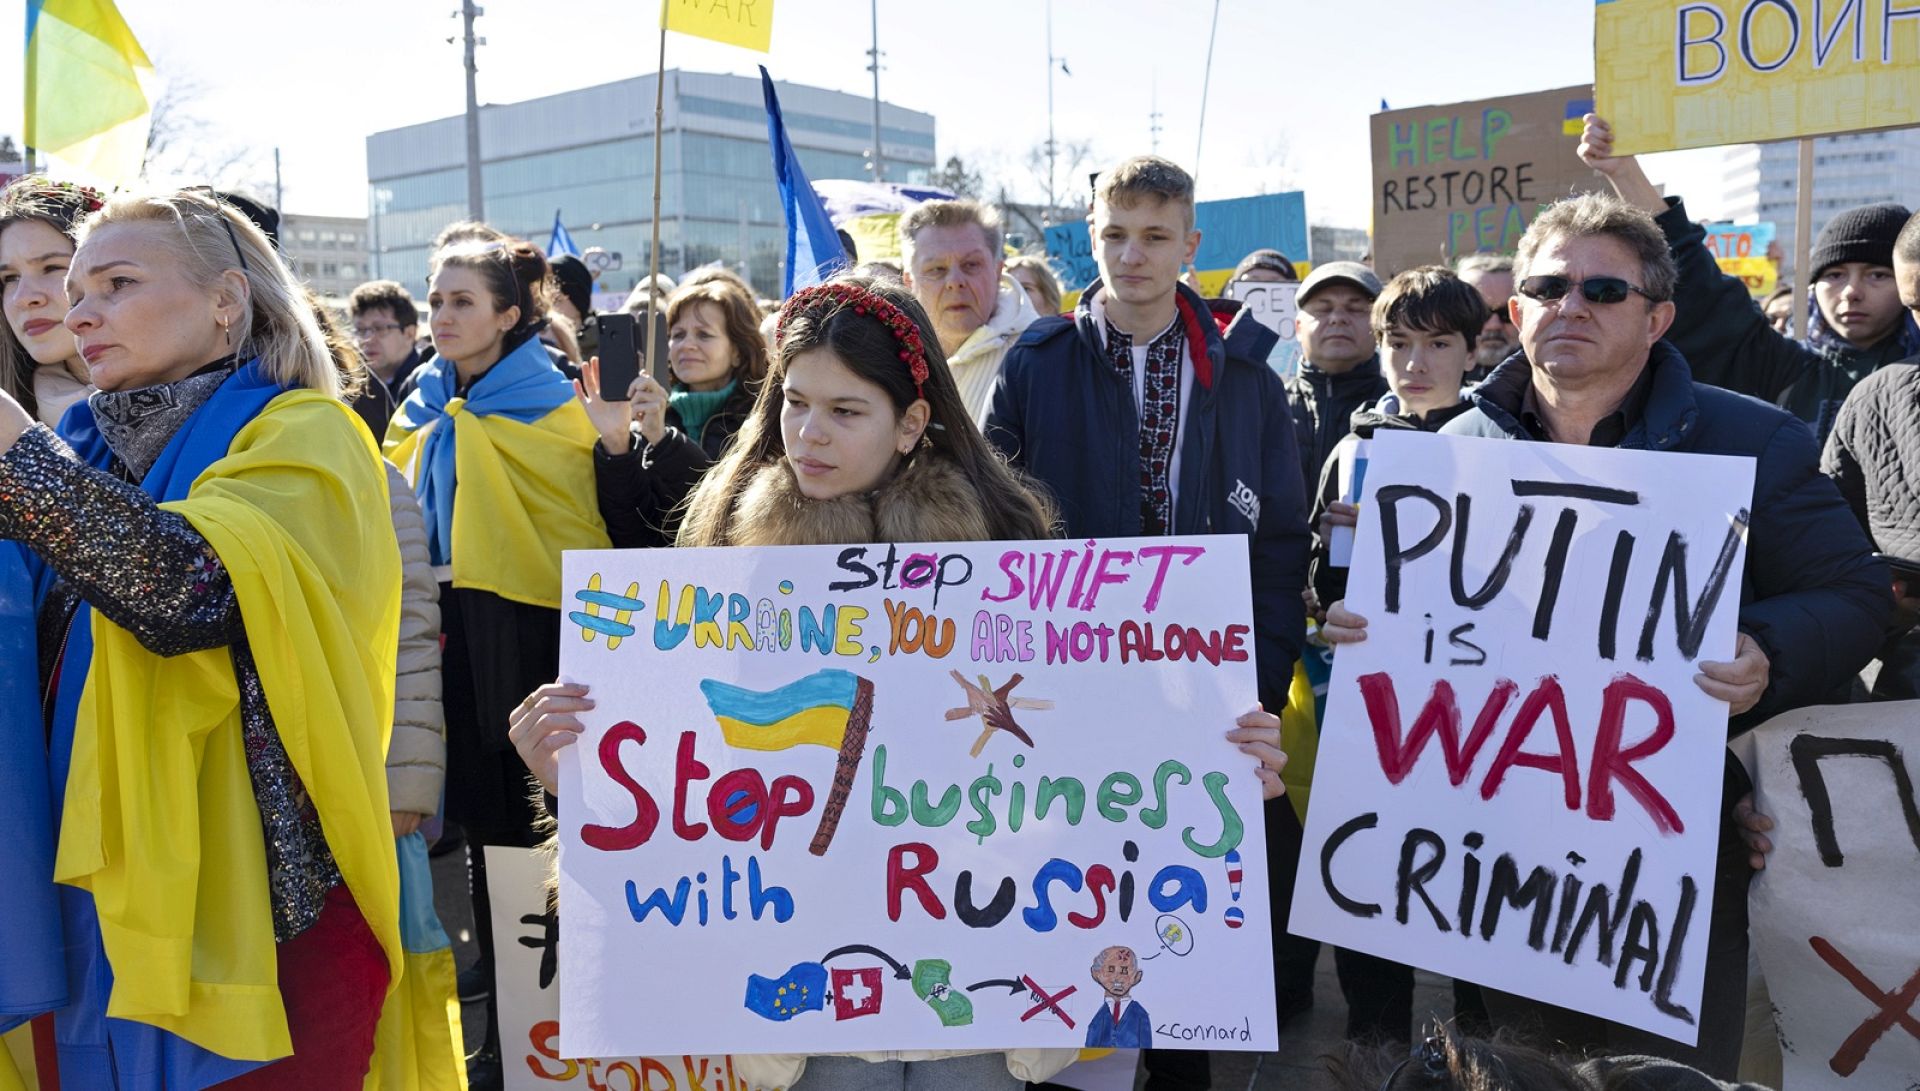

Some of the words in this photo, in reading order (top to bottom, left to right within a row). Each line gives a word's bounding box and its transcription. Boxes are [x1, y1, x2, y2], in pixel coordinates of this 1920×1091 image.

[1387, 107, 1513, 170] HELP
[1383, 162, 1537, 215] RESTORE
[1447, 203, 1546, 256] PEA
[1376, 479, 1750, 661] PUTIN
[884, 598, 956, 659] YOU
[971, 610, 1035, 662] ARE
[1119, 620, 1250, 666] ALONE
[580, 721, 815, 851] Stop
[1356, 671, 1684, 836] WAR
[625, 855, 794, 926] with
